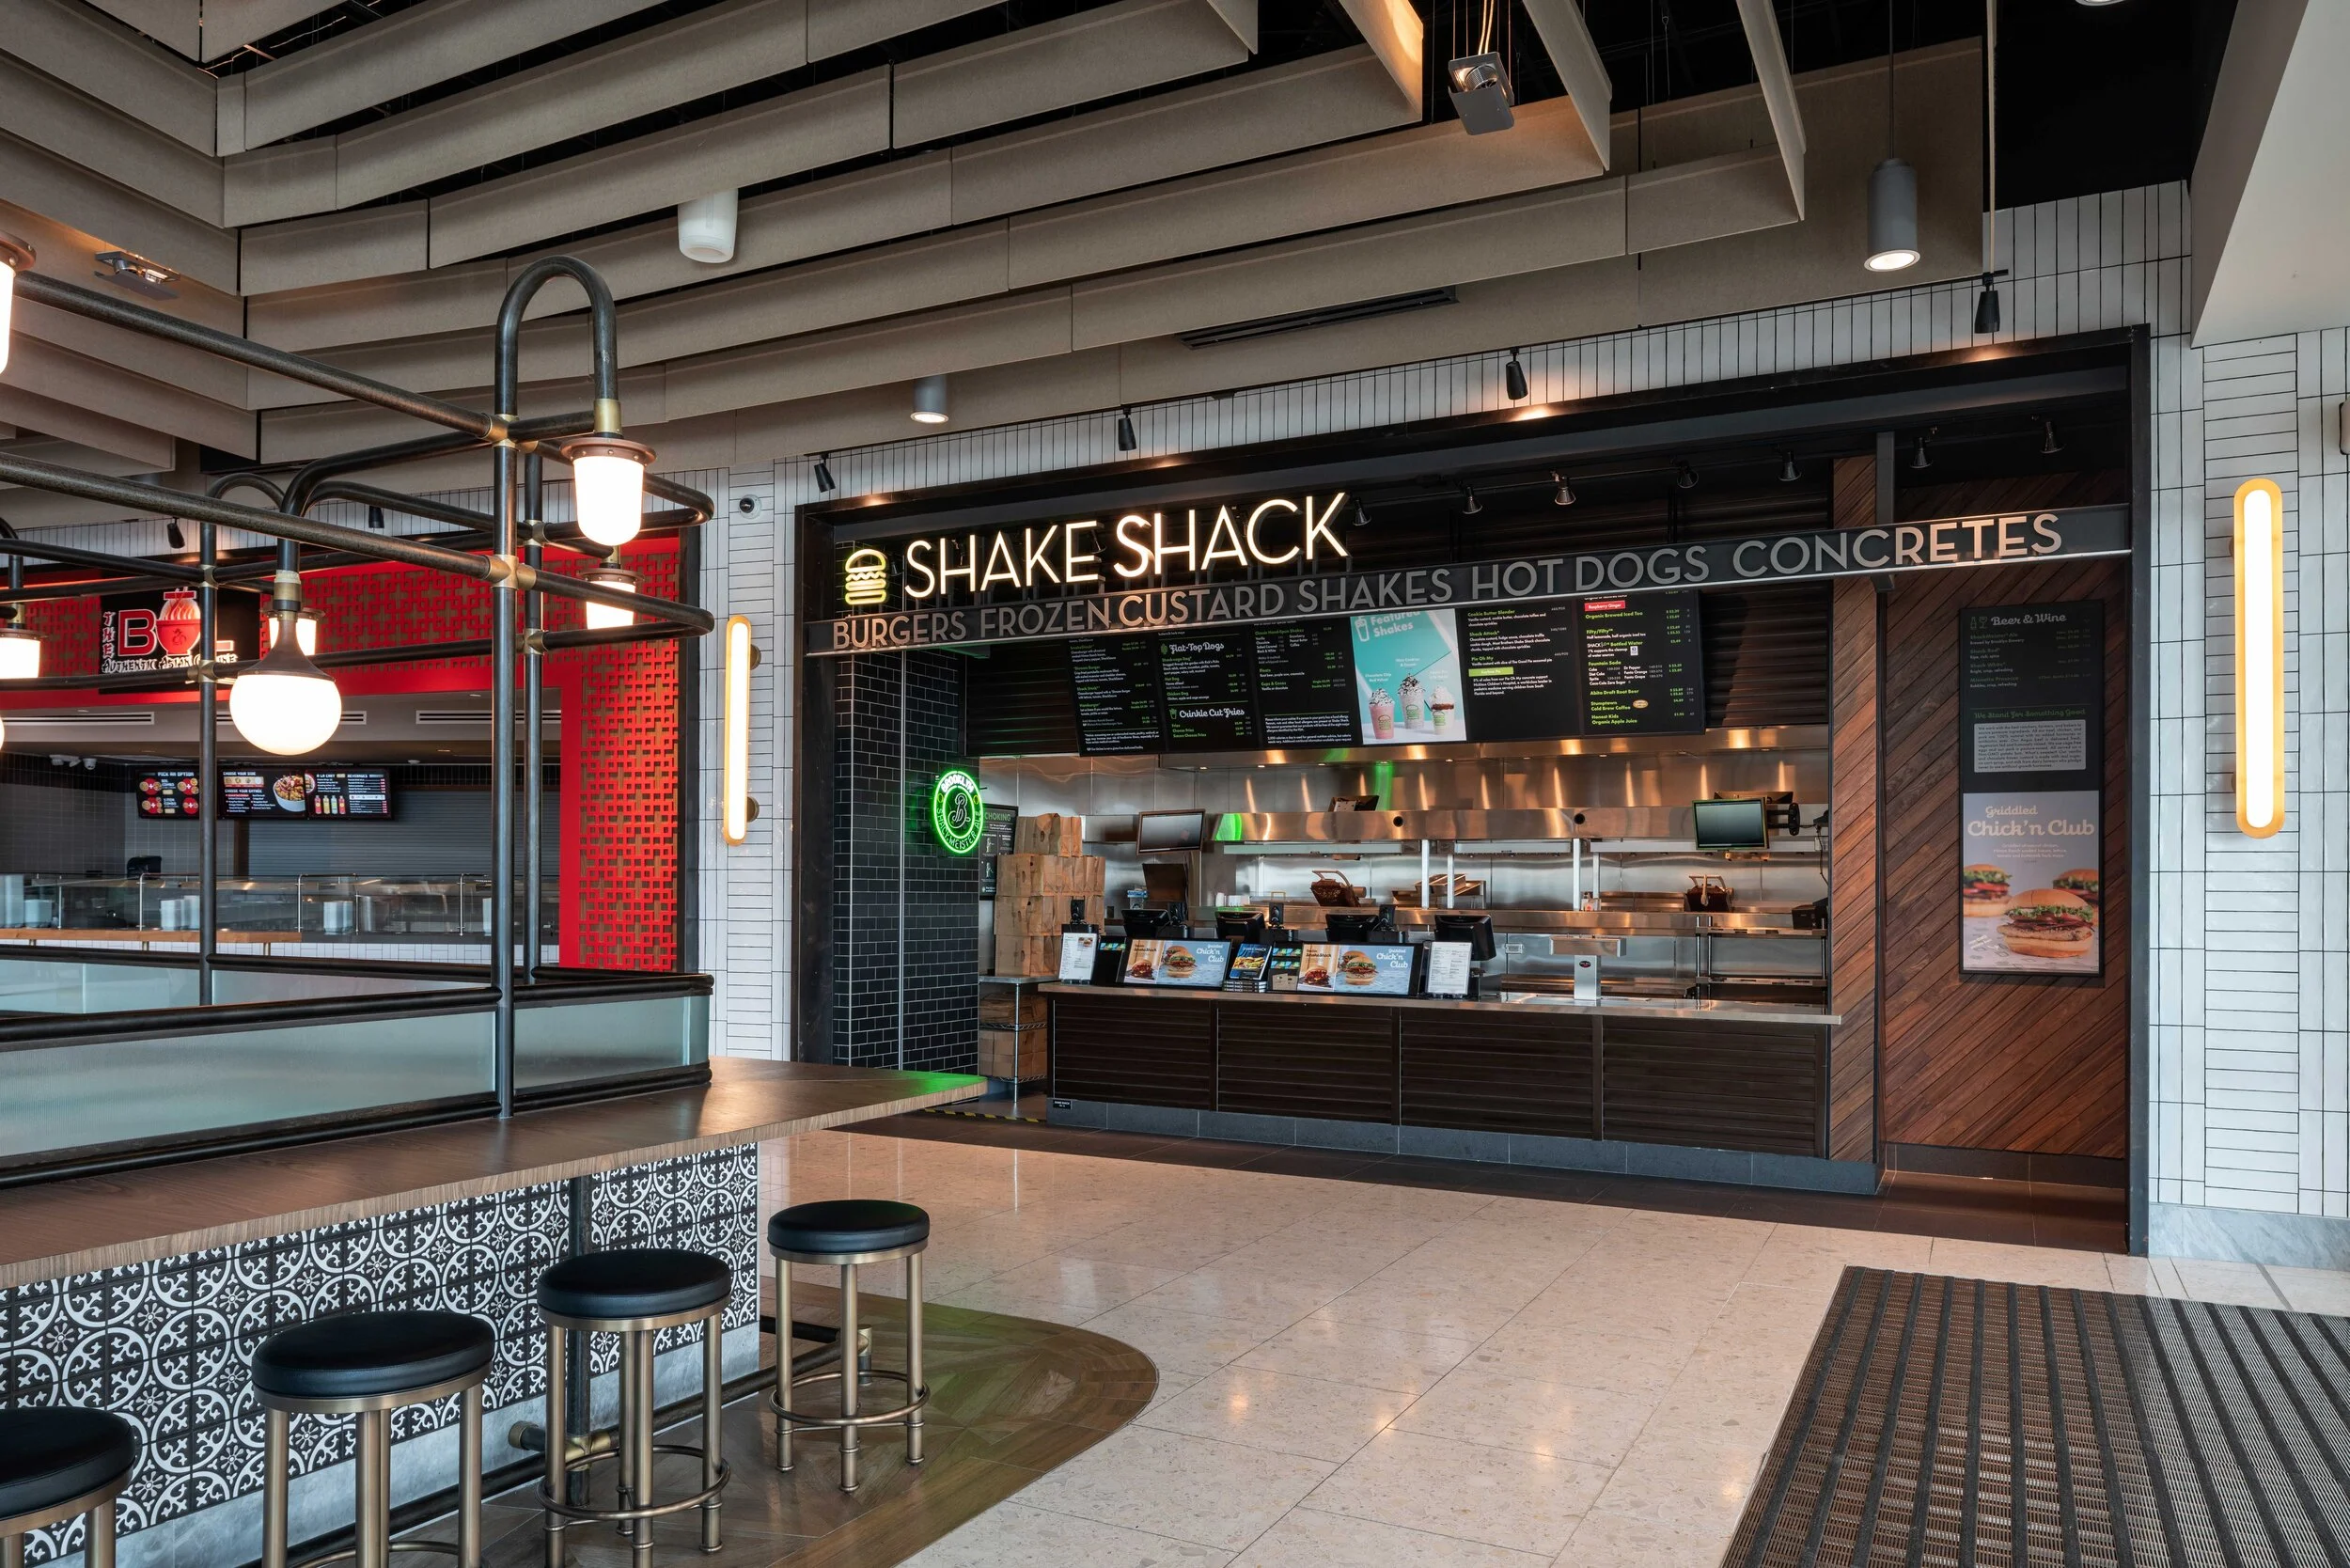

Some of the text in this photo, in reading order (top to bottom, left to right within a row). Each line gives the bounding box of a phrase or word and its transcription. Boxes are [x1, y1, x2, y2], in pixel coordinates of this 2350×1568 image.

[903, 491, 1350, 598] SHAKE SHACK
[832, 513, 2062, 651] BURGERS FROZEN CUSTARD SHAKES HOT DOGS CONCRETES
[1990, 613, 2067, 626] Beer & Wine
[1373, 622, 1414, 637] Shakes
[1168, 641, 1225, 655] Flat-Top Dogs
[102, 658, 159, 674] AUTHENTIC
[1179, 707, 1246, 718] Crinkle Cut Fries
[941, 774, 975, 793] BROOKLYN
[984, 812, 1011, 822] CHOKING
[1985, 805, 2039, 819] Griddled
[1966, 819, 2095, 837] Chick'n Club
[1376, 952, 1404, 961] Chick'n
[1389, 960, 1409, 968] Club
